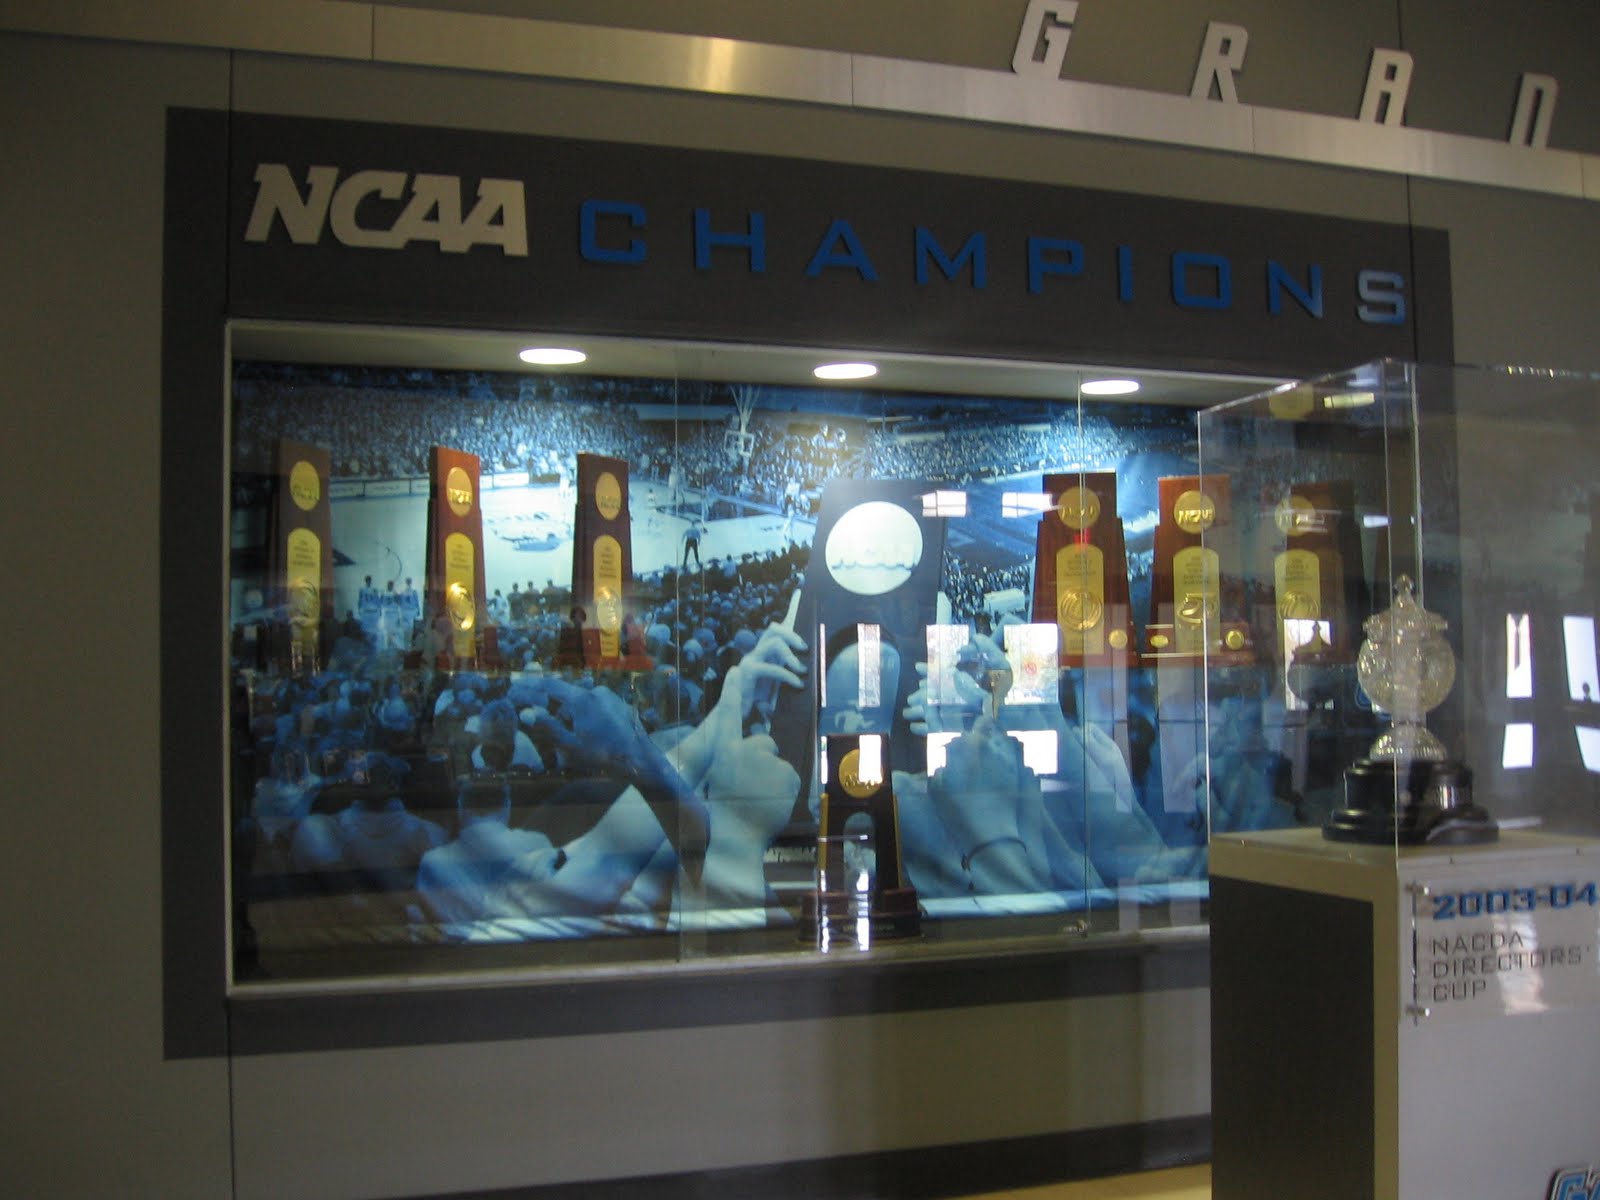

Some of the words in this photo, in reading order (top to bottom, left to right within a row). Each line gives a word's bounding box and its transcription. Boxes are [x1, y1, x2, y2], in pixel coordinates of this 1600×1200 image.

[245, 163, 528, 257] NCAA
[578, 198, 1407, 324] CHAMPIONS
[1432, 882, 1598, 920] 2003-04
[1432, 930, 1525, 955] NACDA
[1432, 979, 1487, 1003] CUP
